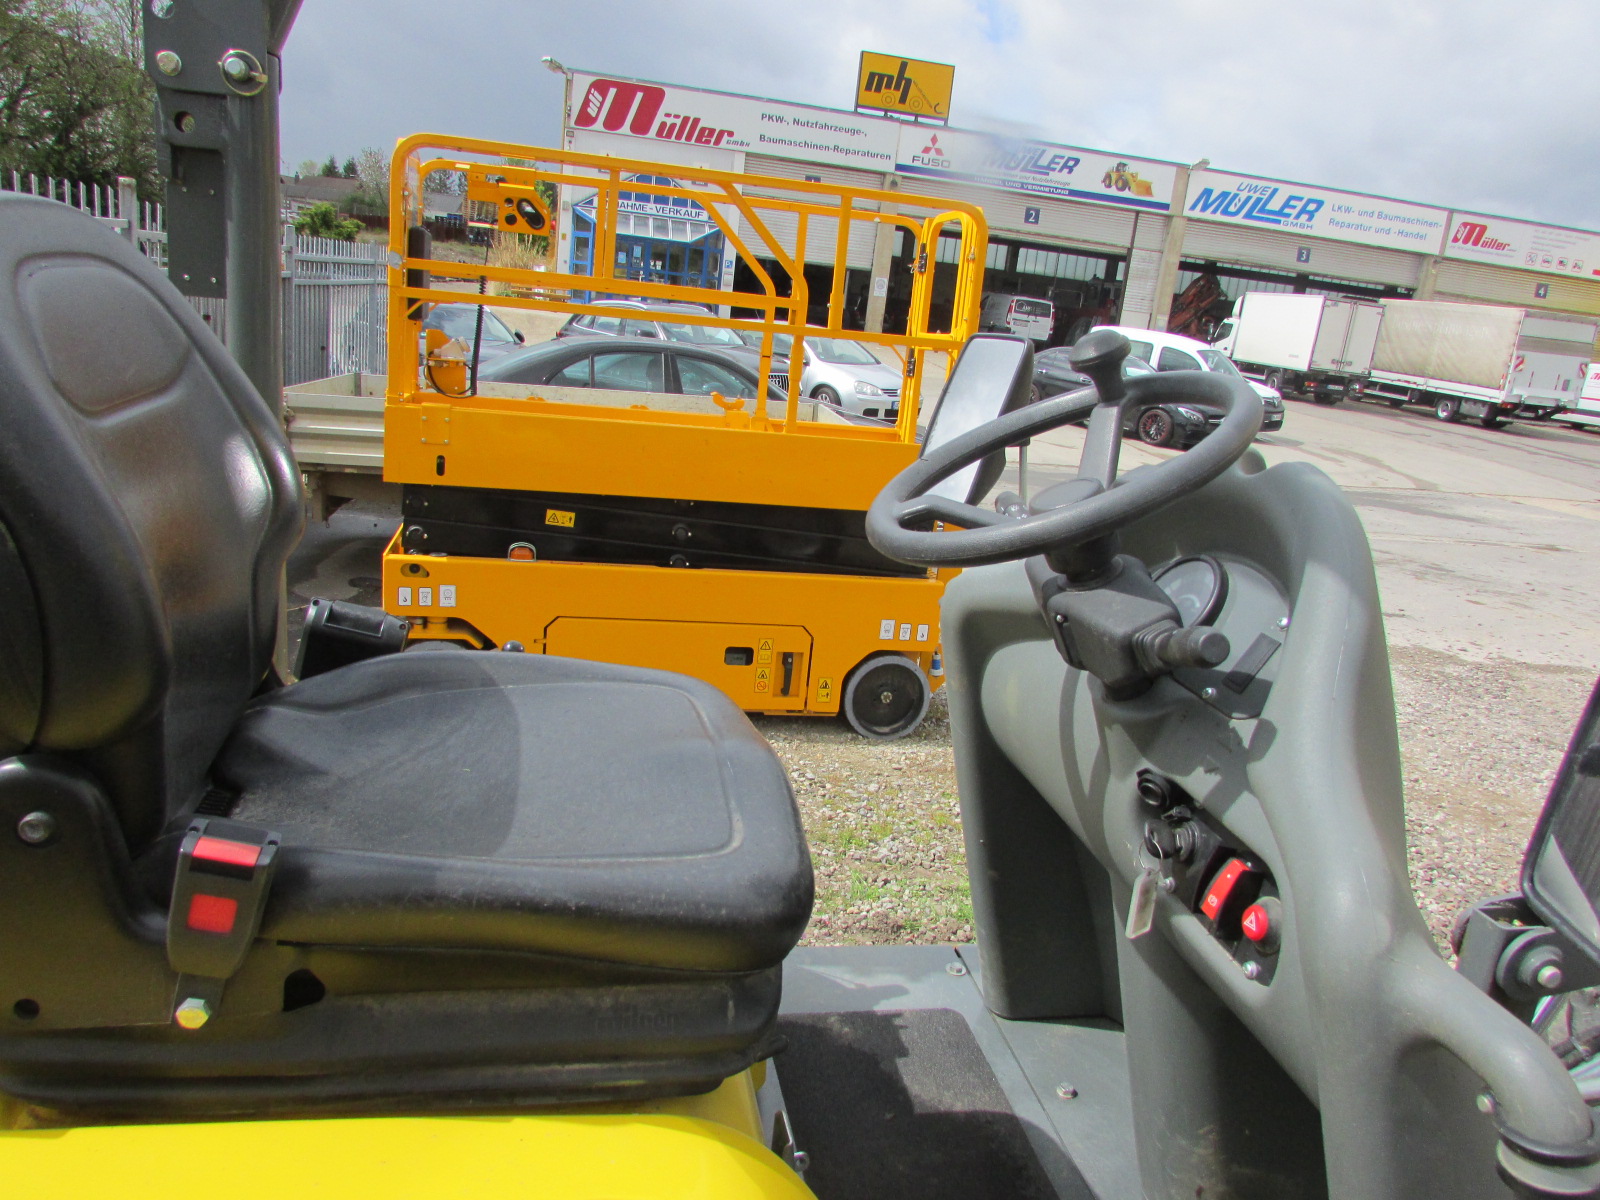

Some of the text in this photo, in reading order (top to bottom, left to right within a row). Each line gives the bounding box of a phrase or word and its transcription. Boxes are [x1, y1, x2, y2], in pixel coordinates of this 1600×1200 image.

[864, 60, 913, 105] mh
[574, 79, 735, 146] Müller
[761, 113, 867, 137] PKW-, Nutzfahrzeuge-,
[759, 134, 891, 161] Baumaschinen-Reparaturen
[912, 155, 951, 169] FUSO
[1023, 184, 1069, 195] VERMIETUNG
[1236, 181, 1272, 197] UWE
[655, 205, 704, 219] VERKAUF
[1331, 203, 1442, 229] LKW- und Baumaschinen-
[1282, 220, 1314, 231] GMBH
[1328, 217, 1373, 233] Reparatur
[1374, 225, 1392, 236] und
[1451, 222, 1510, 251] Müller
